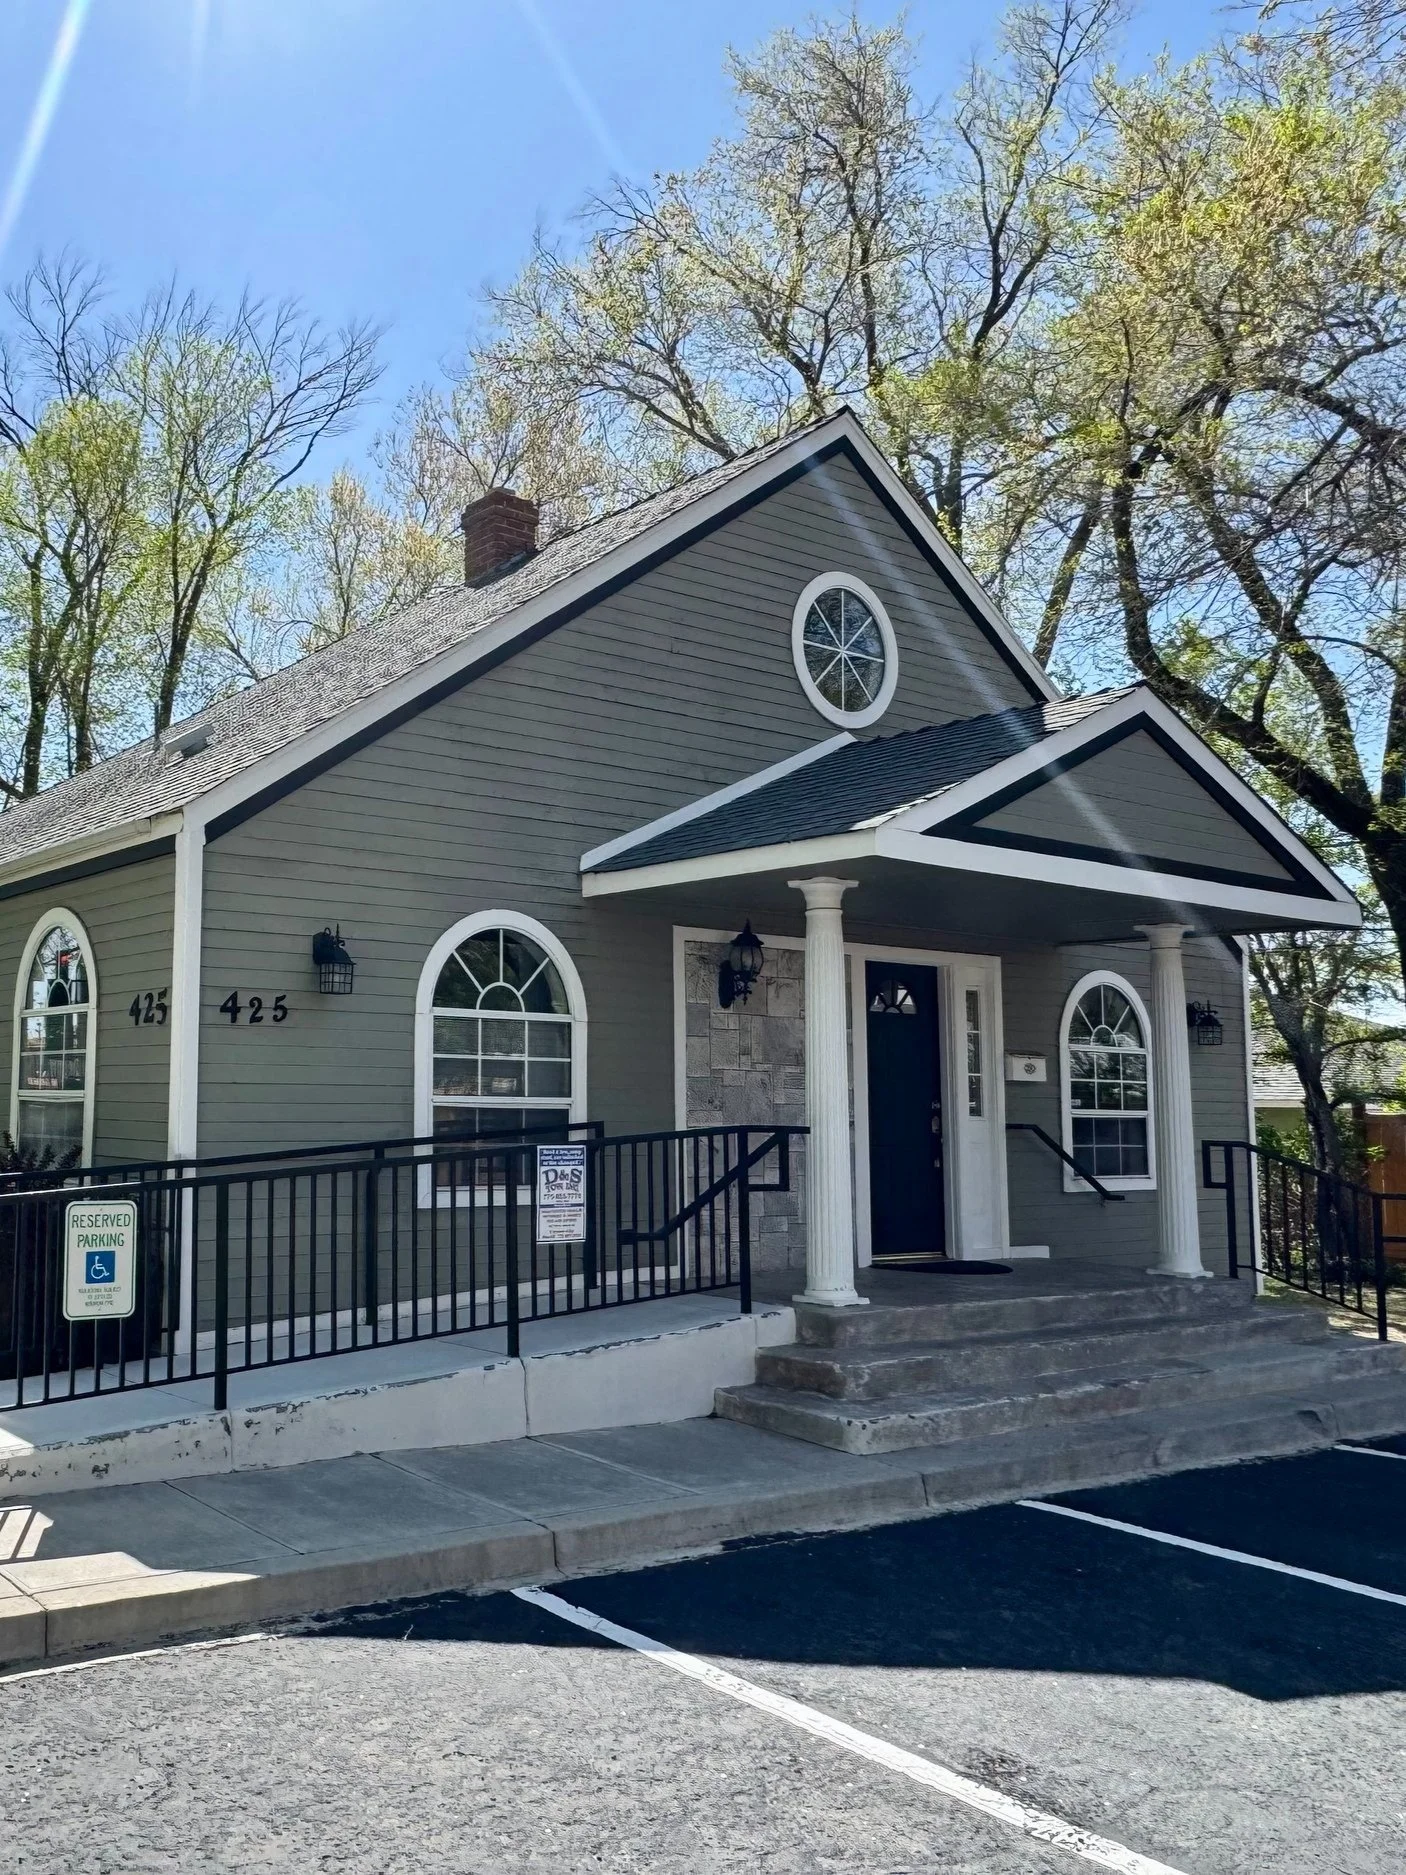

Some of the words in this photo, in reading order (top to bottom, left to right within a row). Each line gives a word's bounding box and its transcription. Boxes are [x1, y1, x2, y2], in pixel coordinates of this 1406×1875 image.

[129, 987, 168, 1026] 425
[220, 991, 288, 1024] 425
[542, 1168, 583, 1185] D&S
[71, 1213, 131, 1229] RESERVED
[77, 1233, 125, 1248] PARKING
